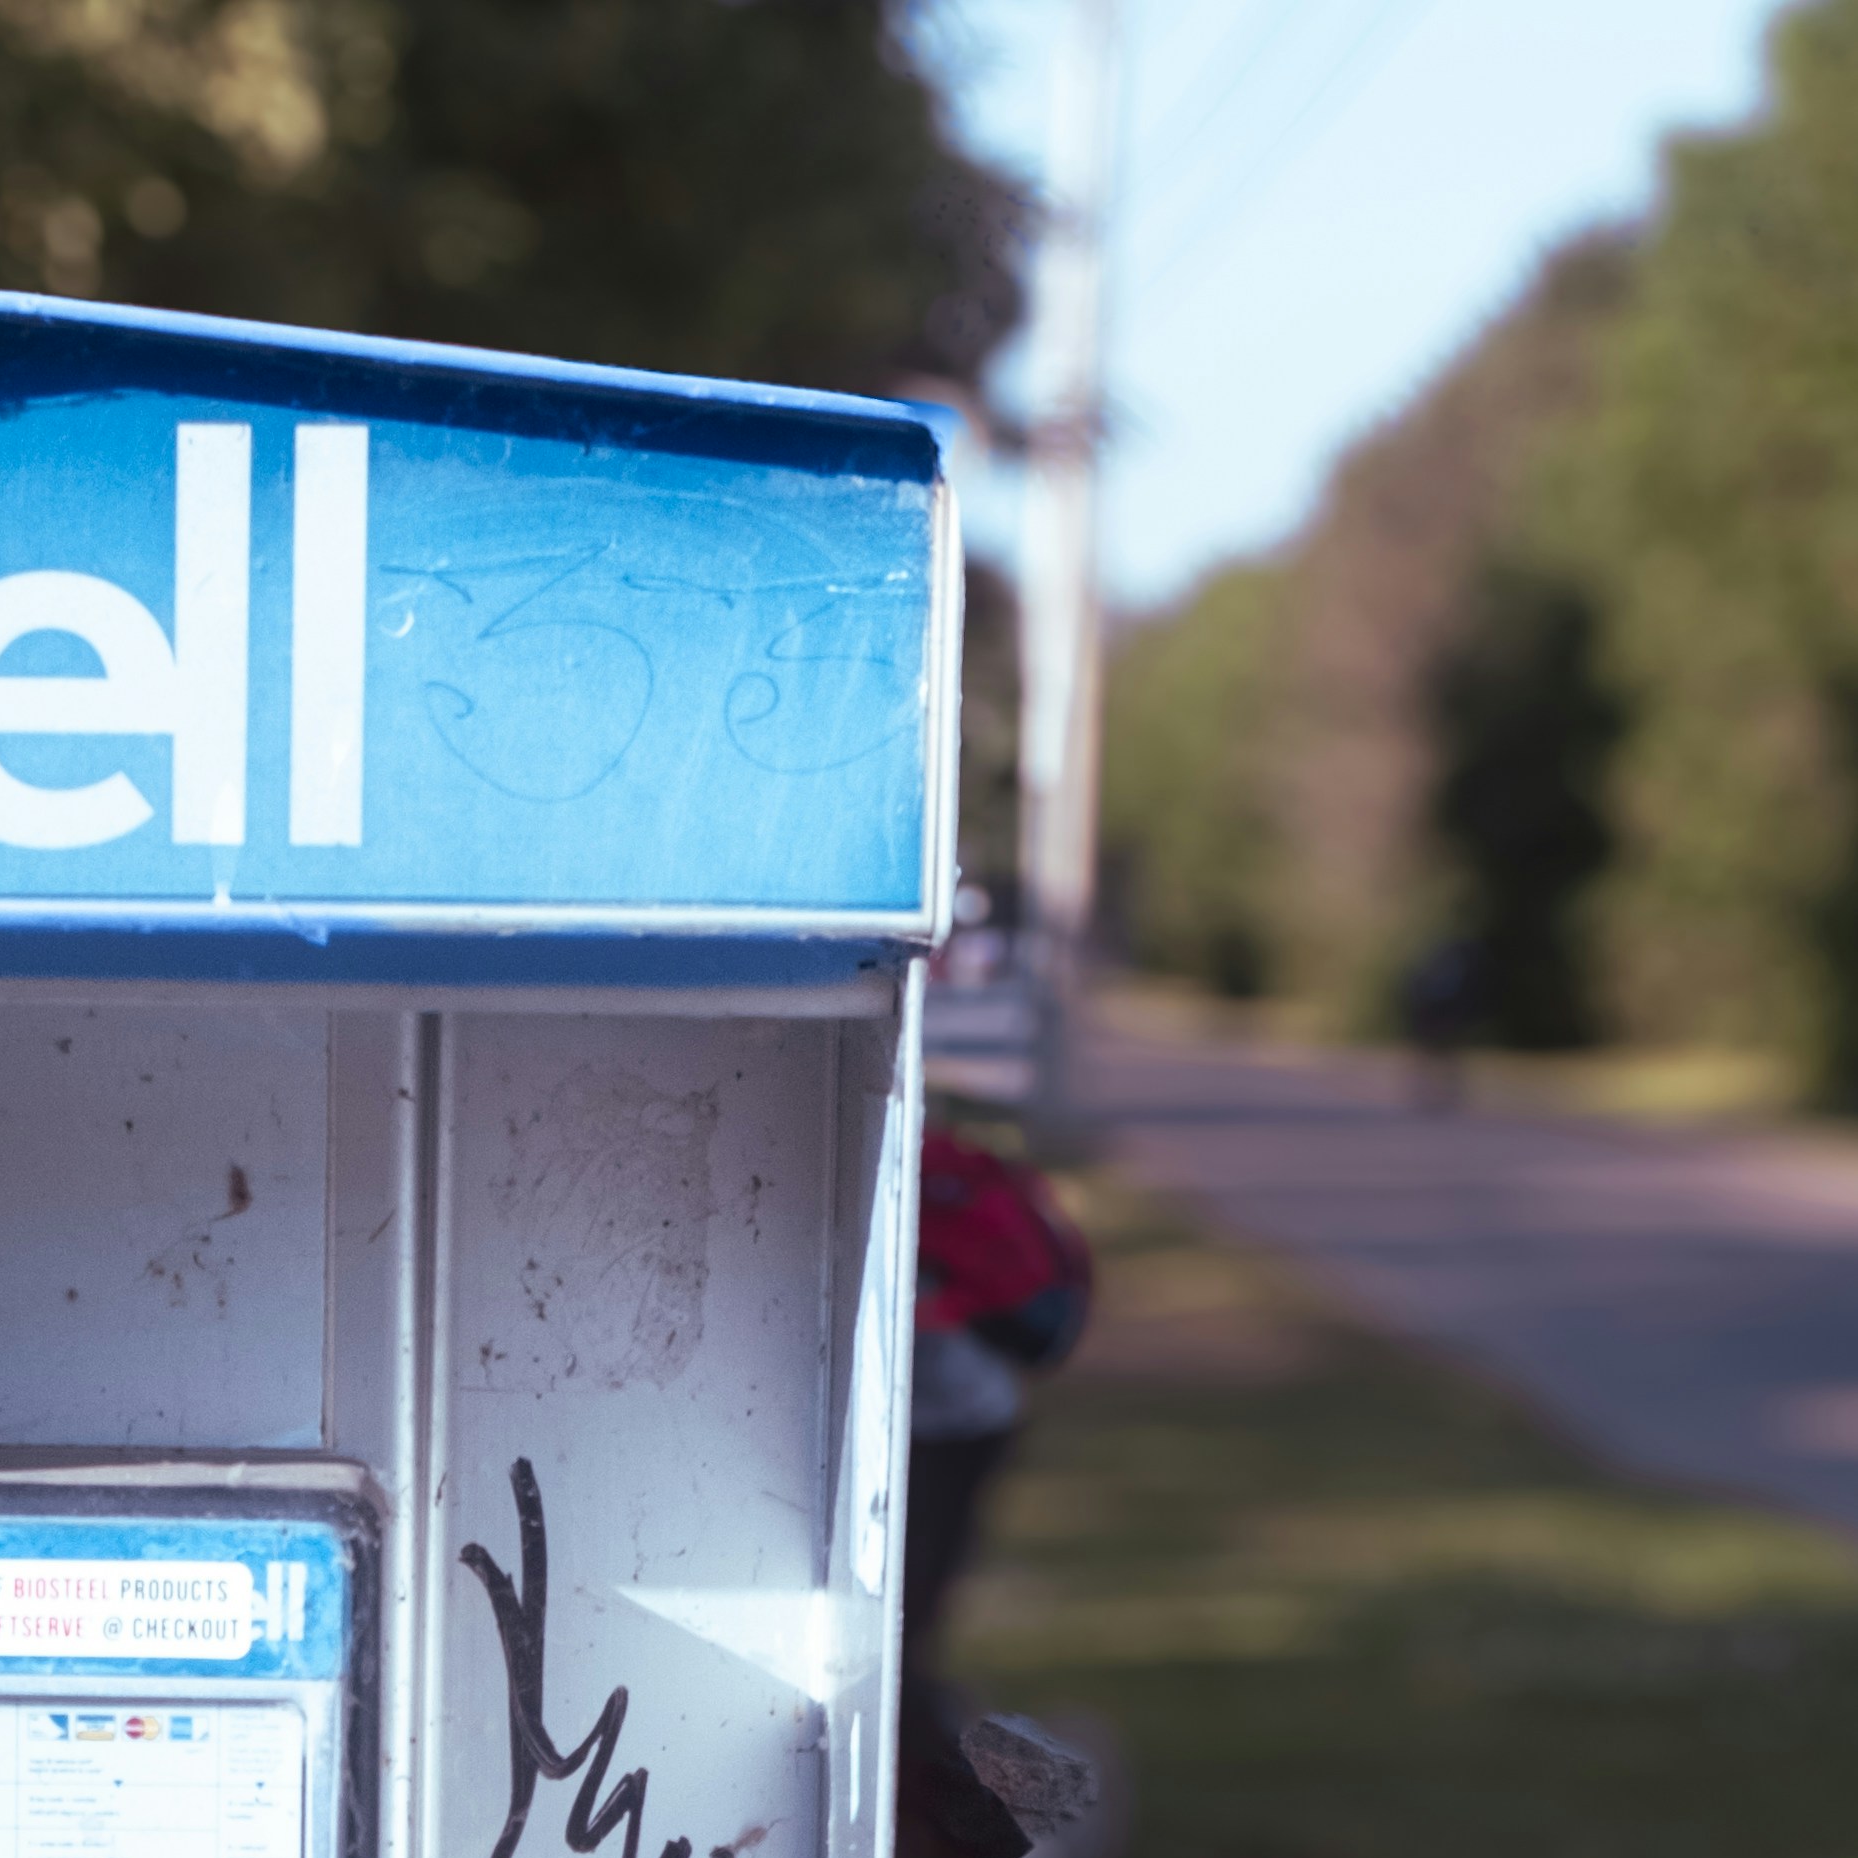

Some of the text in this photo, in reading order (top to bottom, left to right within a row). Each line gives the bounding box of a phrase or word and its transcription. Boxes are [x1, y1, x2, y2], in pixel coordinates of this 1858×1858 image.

[13, 1577, 108, 1600] BIOSTEEL
[120, 1578, 228, 1602] PRODUCTS
[102, 1616, 123, 1641] @
[132, 1617, 238, 1640] CHECKOUT
